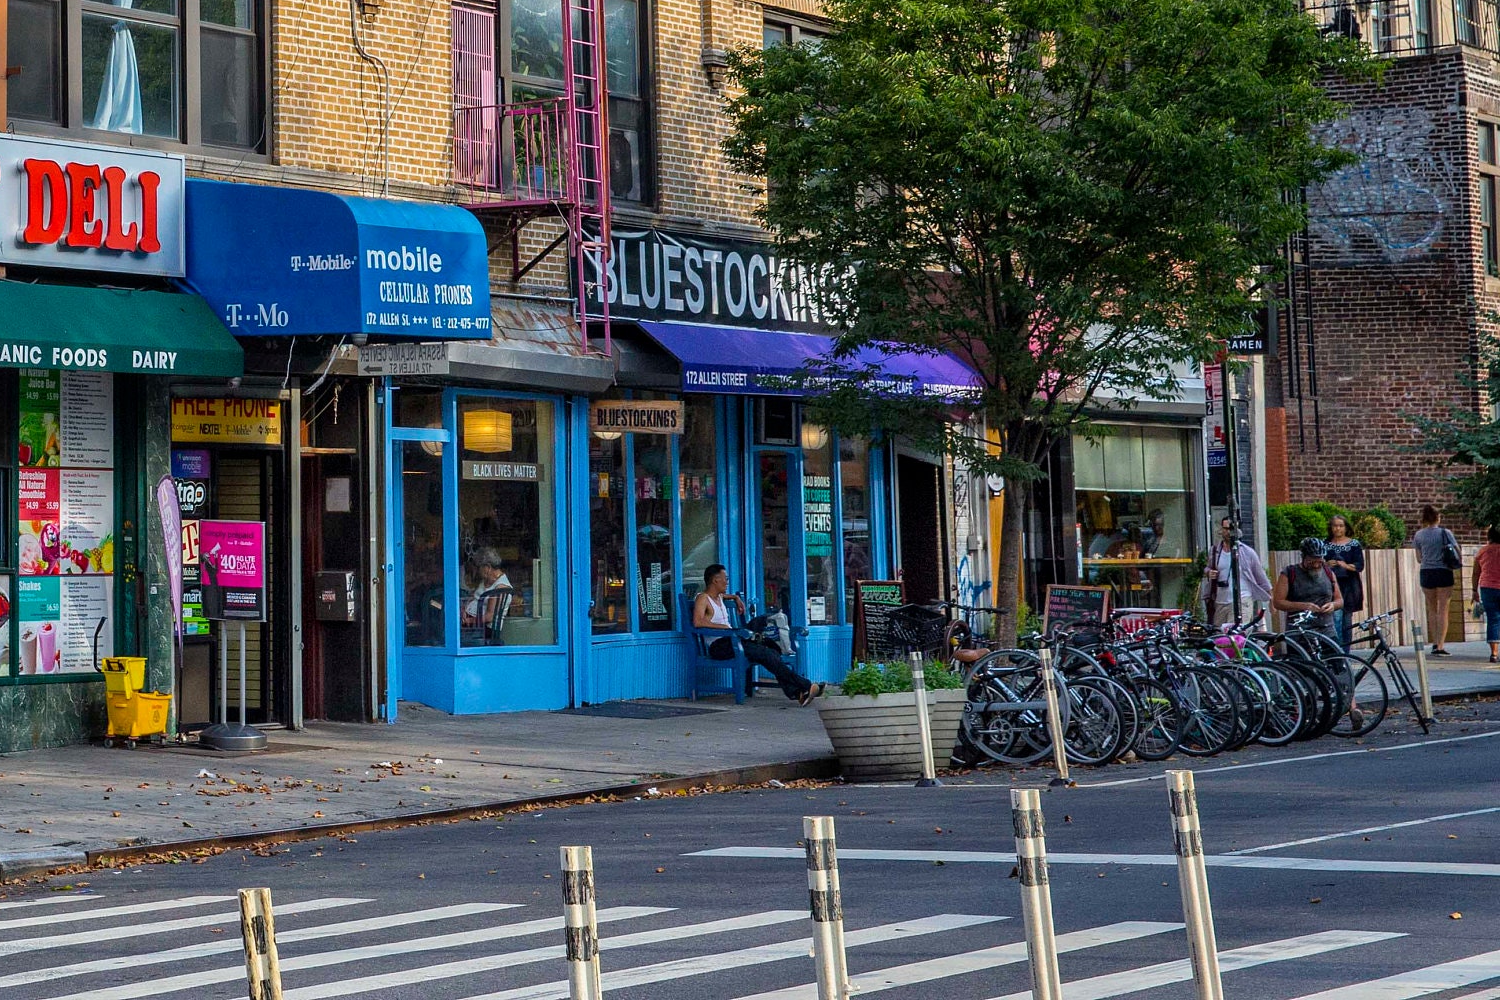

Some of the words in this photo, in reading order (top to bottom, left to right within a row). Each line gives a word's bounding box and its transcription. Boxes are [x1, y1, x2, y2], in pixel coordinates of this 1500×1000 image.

[16, 157, 162, 253] DELI
[366, 246, 442, 273] mobile
[379, 281, 430, 304] CELLULAR
[434, 284, 473, 305] PHONES
[366, 312, 377, 326] 172
[379, 313, 400, 326] ALLEN
[447, 317, 489, 330] 212-475-4777
[52, 347, 108, 368] FOODS
[132, 350, 178, 370] DAIRY
[28, 379, 44, 388] Juice
[45, 380, 56, 389] Bar
[685, 370, 698, 384] 172
[698, 371, 721, 386] ALLEN
[721, 372, 748, 387] STREET
[223, 398, 276, 418] PHONE
[596, 407, 677, 428] BLUESTOCKINGS
[199, 423, 221, 435] NEXTEL
[19, 472, 46, 482] Refreshing
[473, 463, 493, 478] BLACK
[494, 464, 512, 478] LIVES
[513, 465, 537, 479] MATTER
[26, 481, 46, 490] Natural
[803, 475, 813, 488] RAD
[814, 475, 831, 488] BOOKS
[19, 490, 46, 499] Smoothies
[810, 490, 831, 502] COFFEE
[25, 501, 38, 510] $4.99
[46, 502, 59, 510] $5.99
[804, 503, 831, 513] STIMULATING
[805, 514, 832, 532] EVENTS
[236, 562, 256, 570] DATA
[19, 581, 41, 591] Shakes
